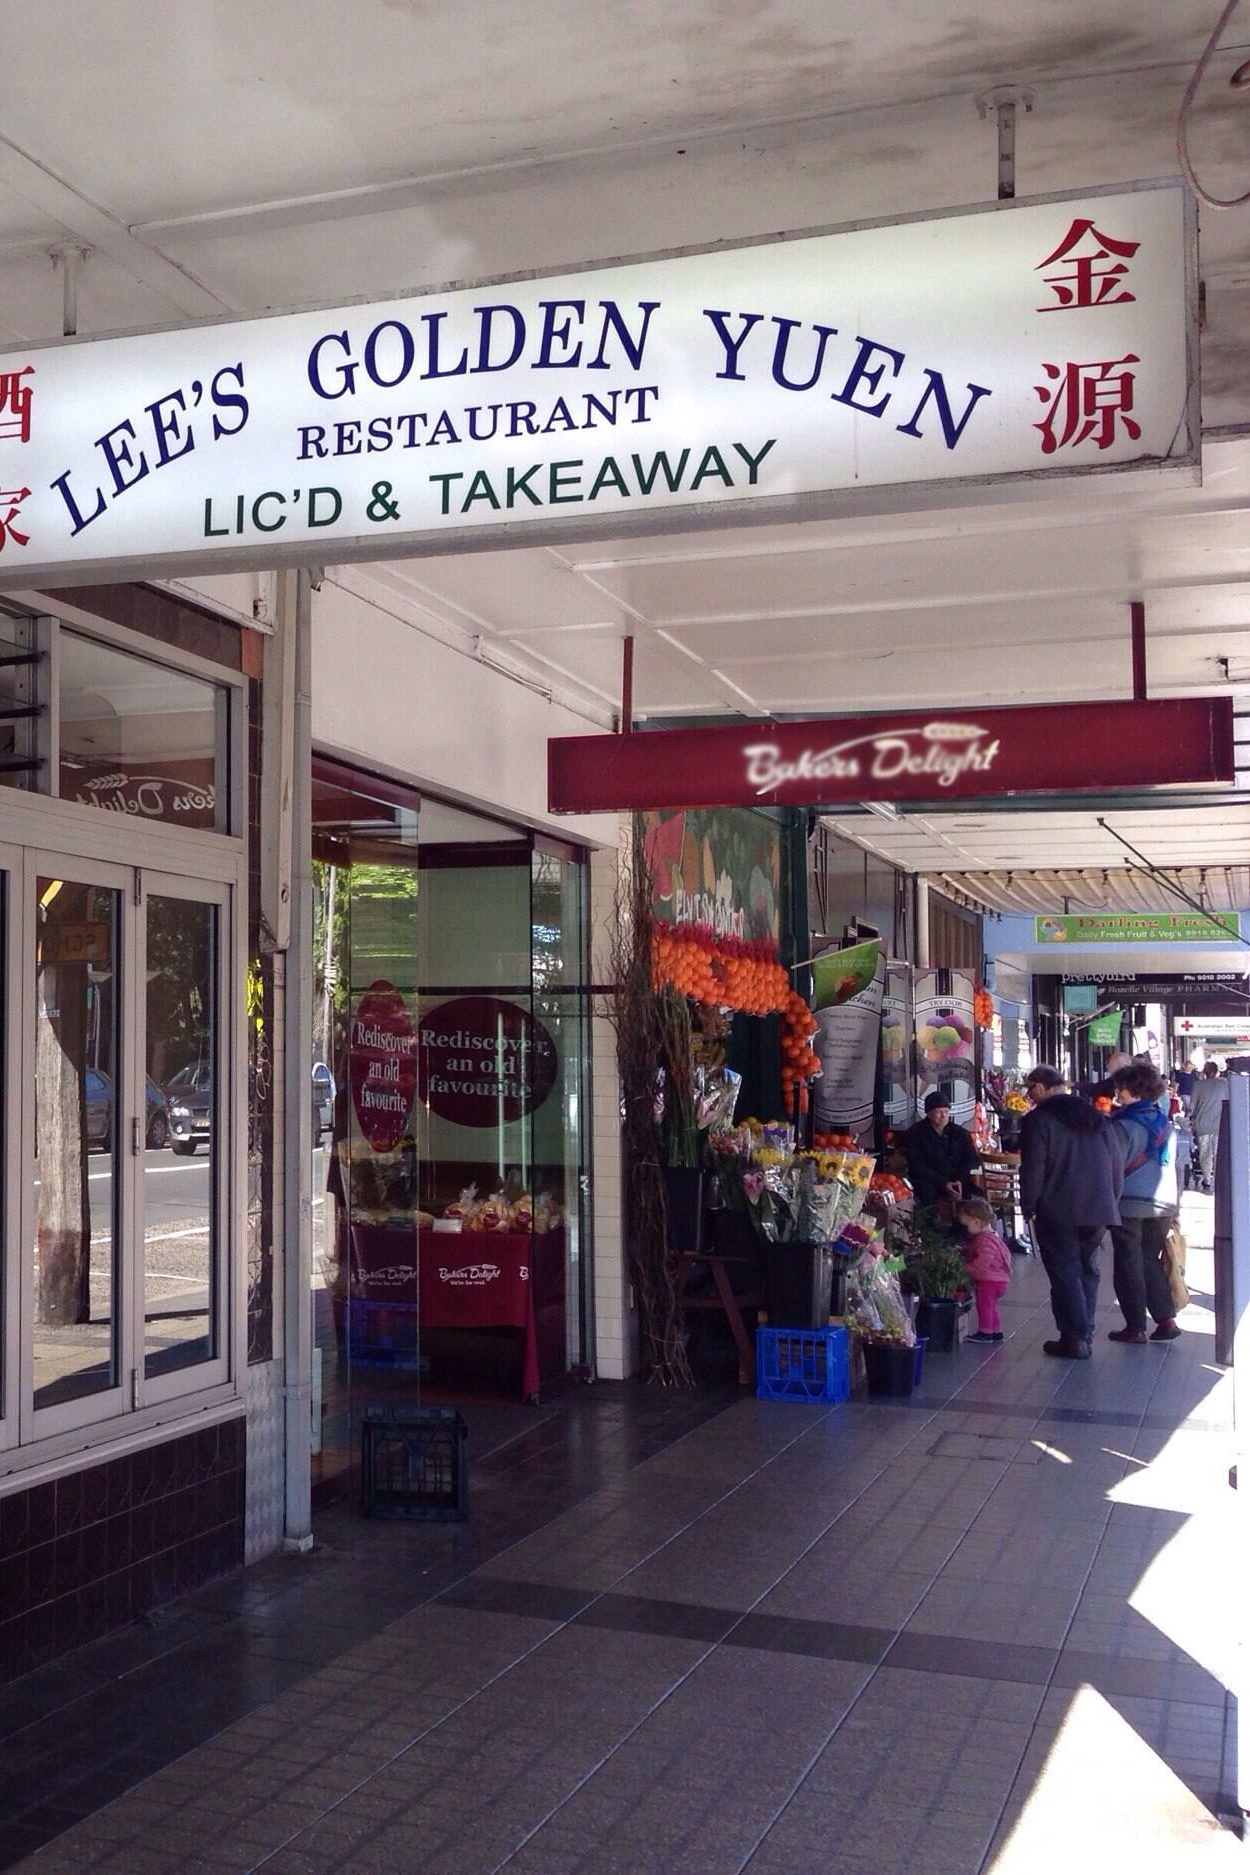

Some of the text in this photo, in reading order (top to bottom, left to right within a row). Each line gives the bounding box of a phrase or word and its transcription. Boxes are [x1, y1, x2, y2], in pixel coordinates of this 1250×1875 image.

[1033, 217, 1143, 455] 金源
[50, 300, 993, 538] LEE'S GOLDEN YUEN
[295, 385, 660, 461] RESTAURANT
[203, 438, 777, 538] LIC'D & TAKEAWAY
[871, 737, 1001, 787] Delight
[1100, 930, 1126, 938] Fresh
[1127, 930, 1148, 938] Fruit
[1061, 973, 1137, 984] prettybird
[356, 1021, 413, 1055] Rediscover
[368, 1058, 400, 1082] an old
[445, 1055, 516, 1075] an old
[360, 1083, 408, 1114] favourite
[428, 1074, 533, 1099] favourite
